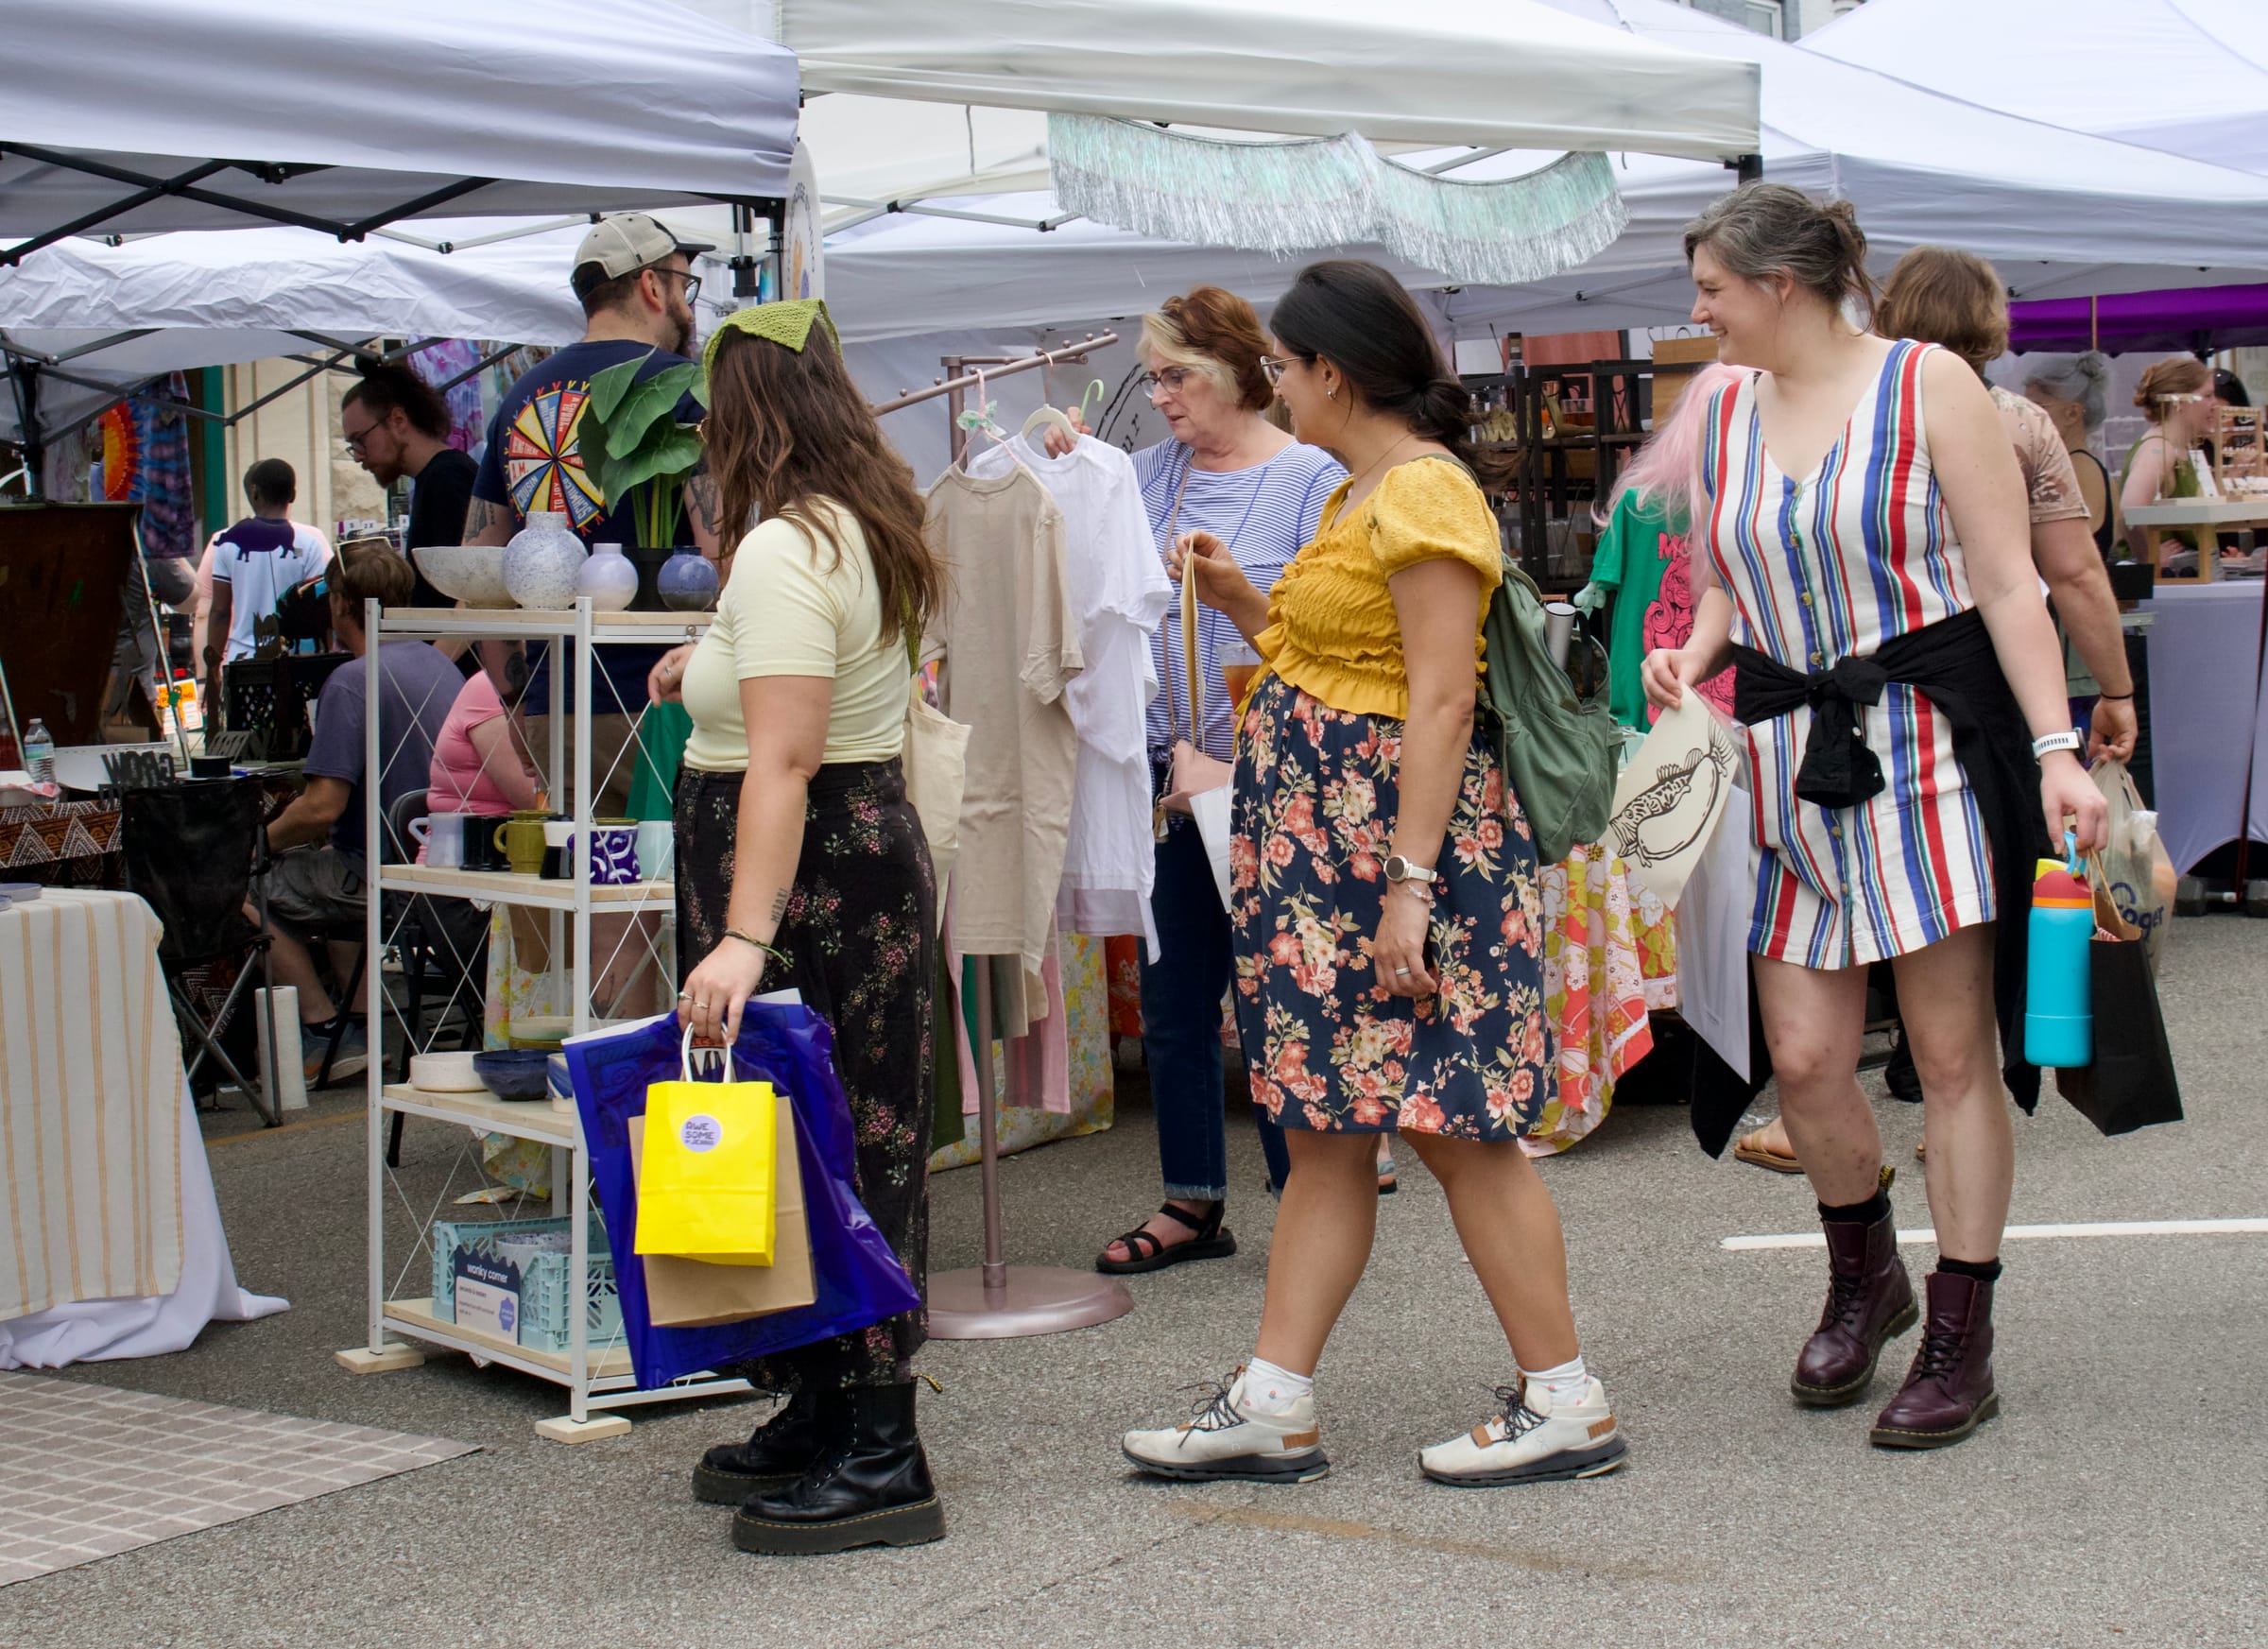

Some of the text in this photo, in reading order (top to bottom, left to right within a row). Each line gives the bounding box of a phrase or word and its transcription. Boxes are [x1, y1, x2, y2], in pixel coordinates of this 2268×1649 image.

[516, 475, 539, 506] COUSIN
[562, 477, 593, 519] SCHMILCO
[685, 1130, 715, 1140] SOME
[466, 1263, 508, 1283] wonky corner
